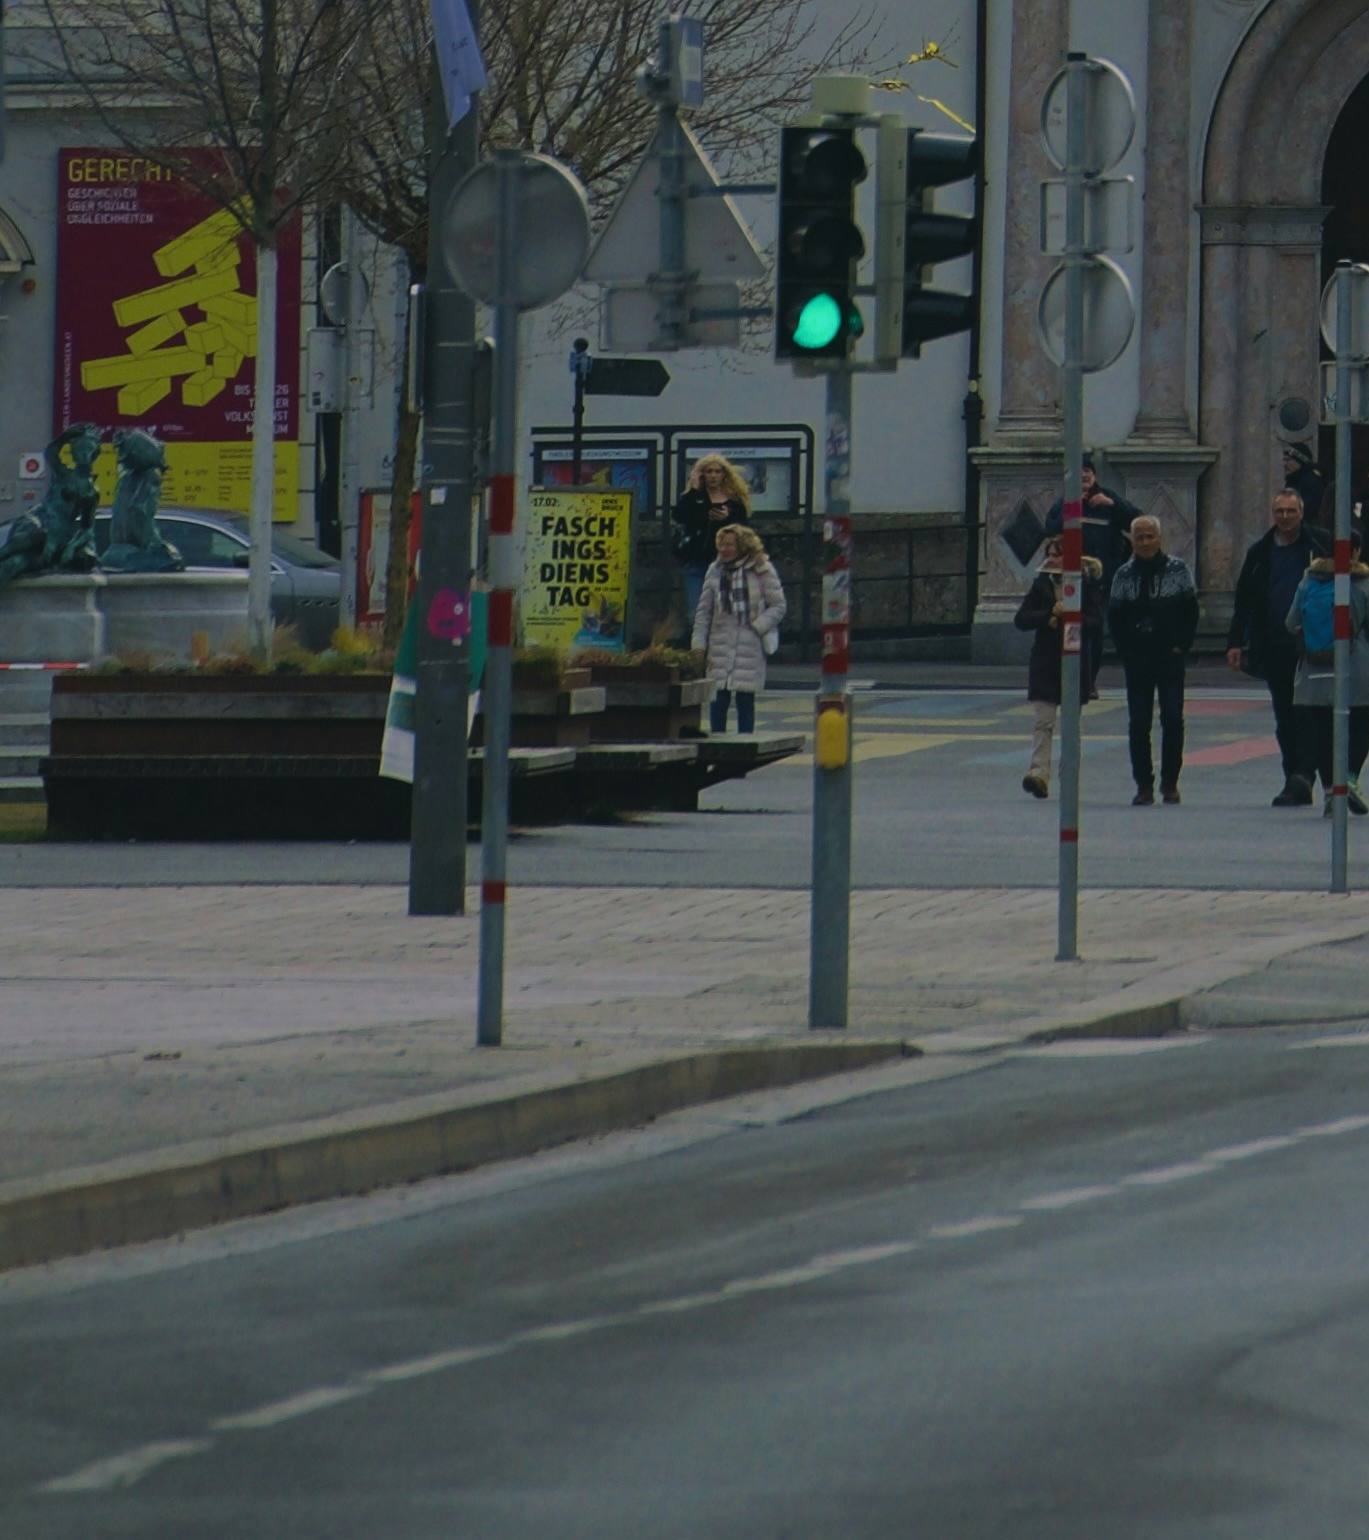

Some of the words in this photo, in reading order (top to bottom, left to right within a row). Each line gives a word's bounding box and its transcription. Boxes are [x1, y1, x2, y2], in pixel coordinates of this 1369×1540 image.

[541, 516, 616, 537] FASCH
[551, 540, 607, 560] INGS
[540, 563, 610, 584] DIENS
[546, 586, 590, 608] TAG
